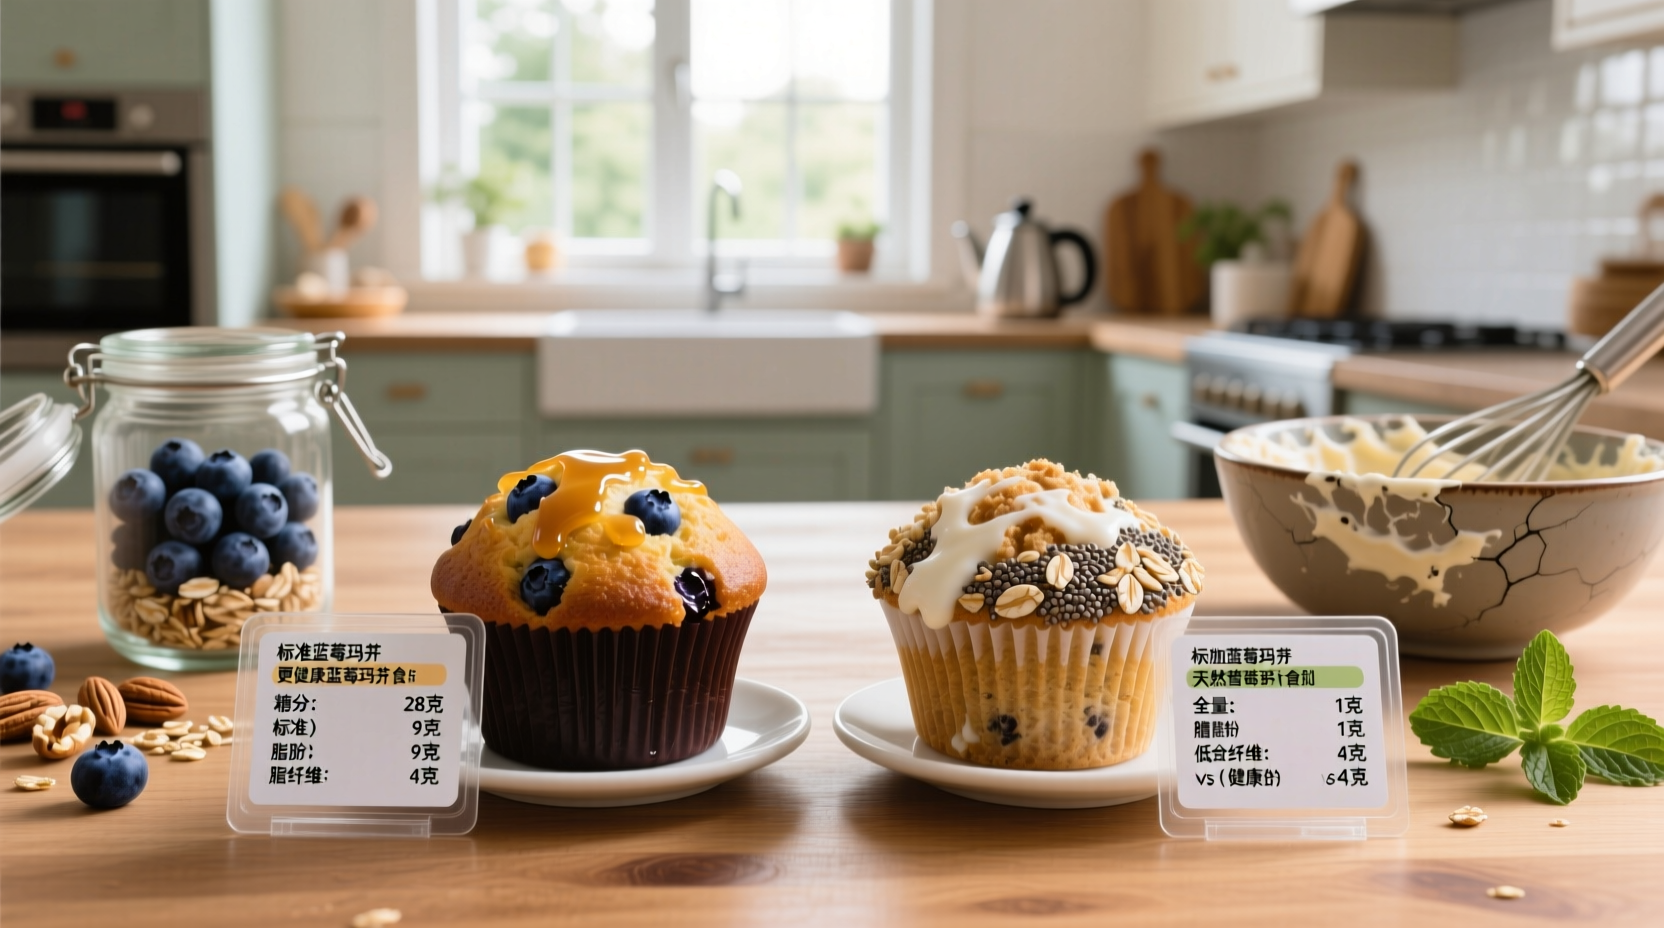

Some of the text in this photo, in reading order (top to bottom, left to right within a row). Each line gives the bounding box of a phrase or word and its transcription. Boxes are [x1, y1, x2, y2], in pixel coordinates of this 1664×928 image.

[404, 694, 444, 713] 28克
[1336, 695, 1363, 714] 1克
[412, 719, 441, 737] 9克
[1338, 719, 1365, 738] 1克
[411, 743, 440, 761] 9克
[1338, 743, 1367, 762] 4克
[410, 767, 439, 785] 4克
